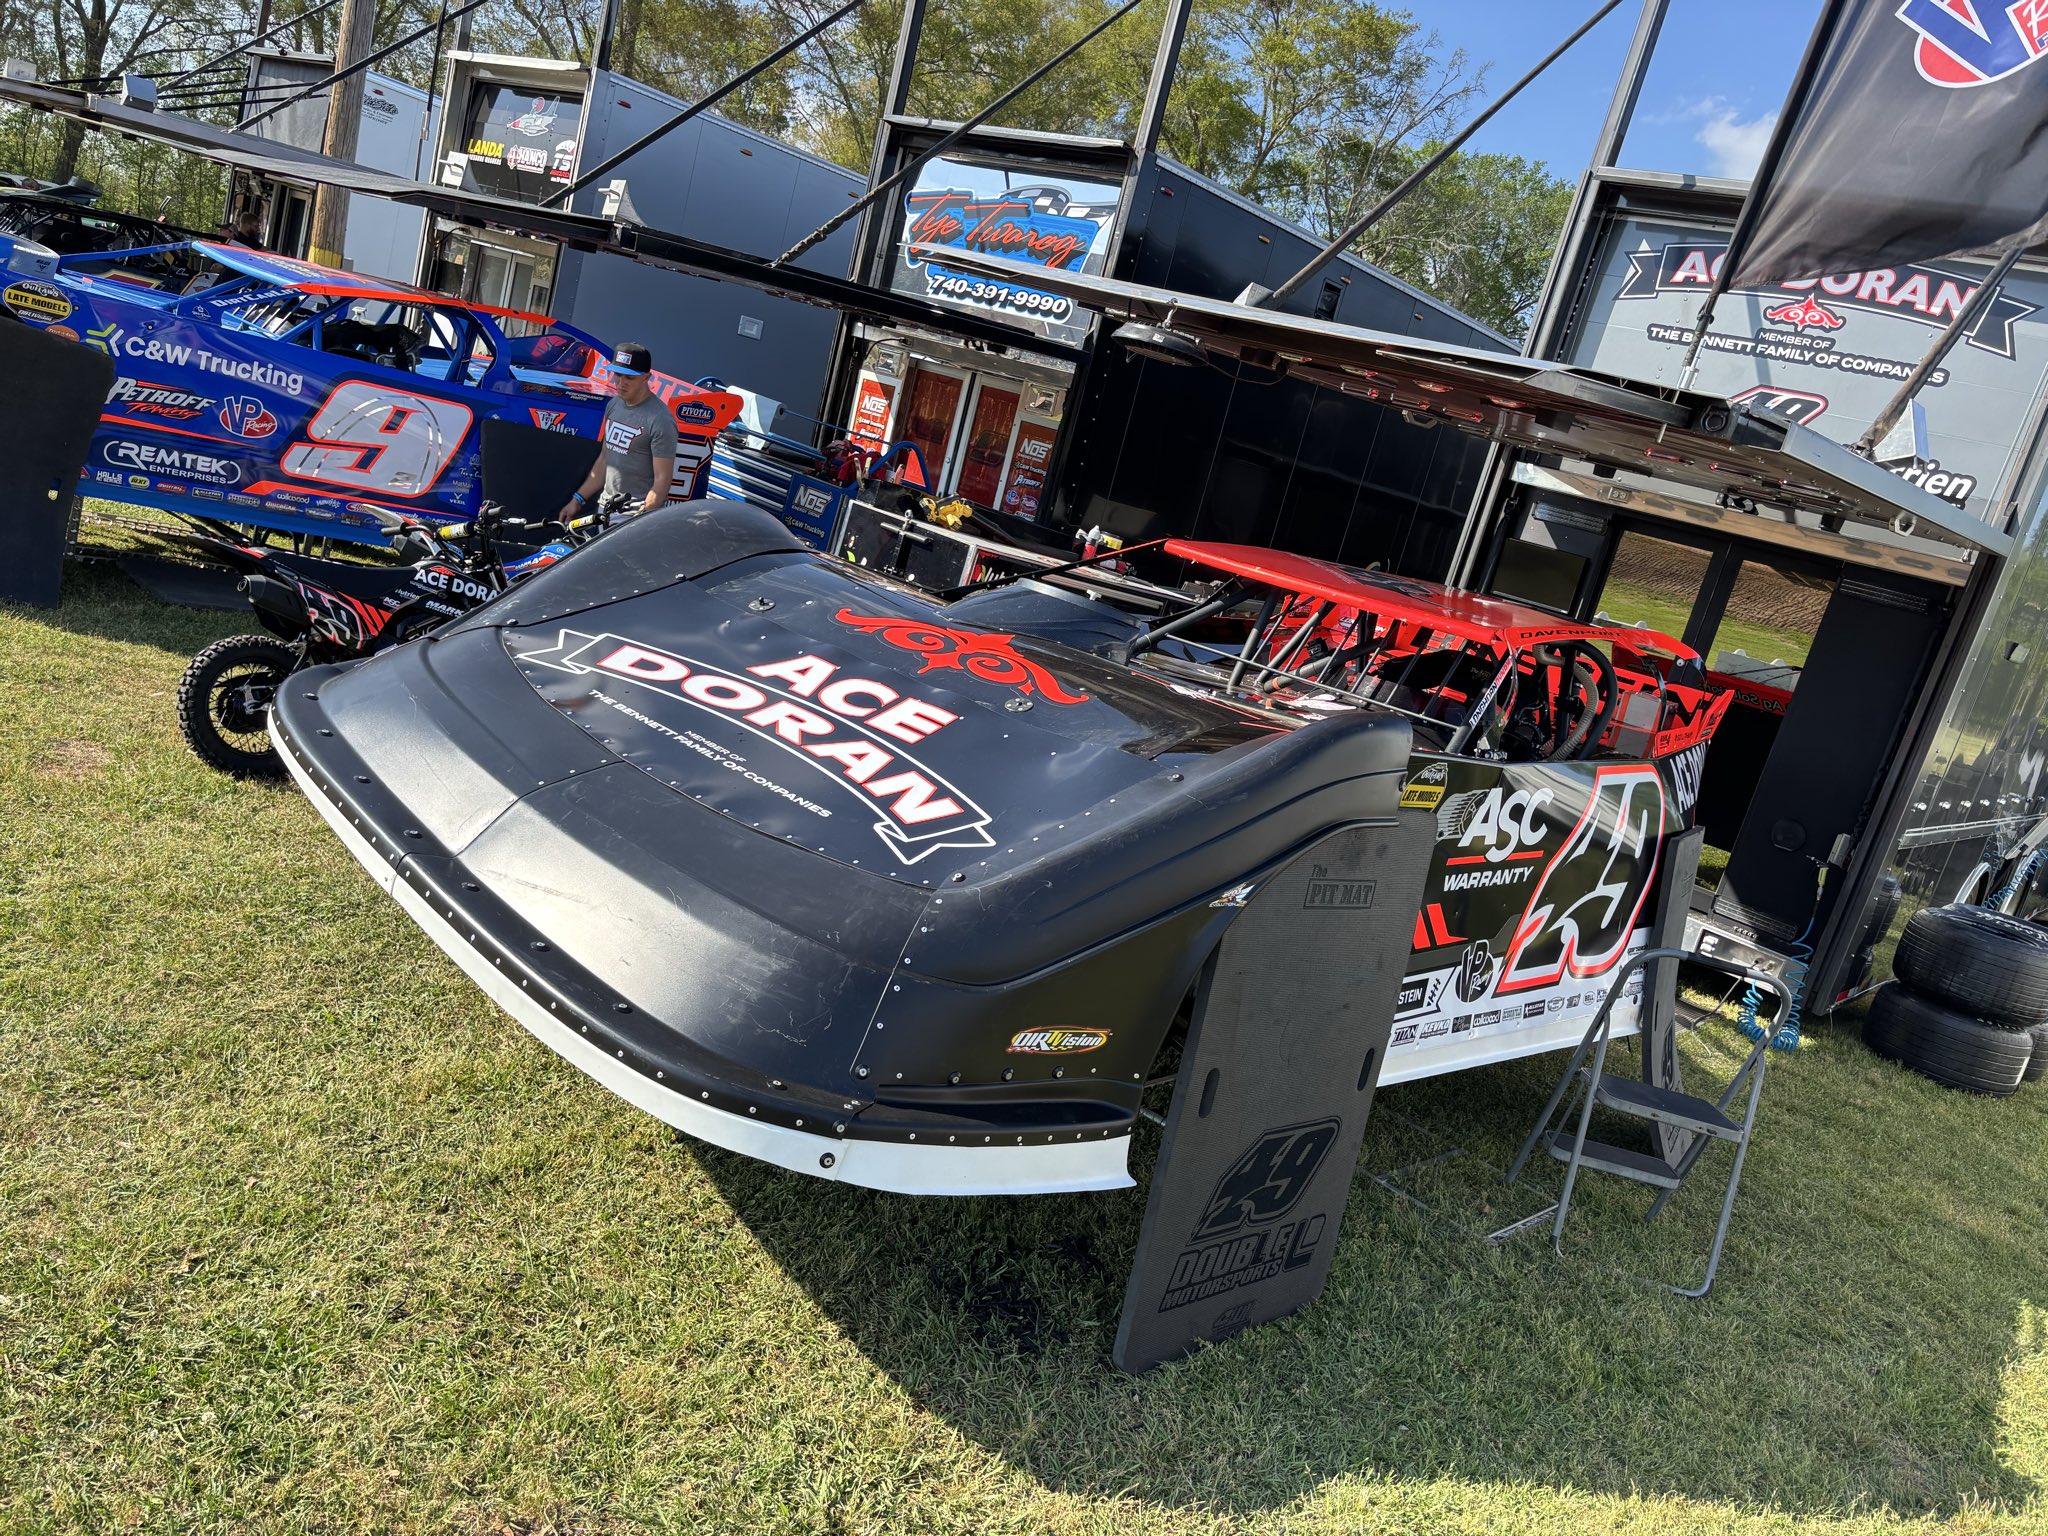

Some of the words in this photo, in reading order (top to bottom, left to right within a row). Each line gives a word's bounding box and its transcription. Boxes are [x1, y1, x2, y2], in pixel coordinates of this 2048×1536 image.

[468, 139, 504, 158] LANDA
[8, 291, 30, 305] LATE
[31, 297, 68, 313] MODELS
[932, 274, 1067, 314] 740-391-9990
[1650, 327, 1680, 342] THE
[1682, 331, 1754, 353] BNNETT
[1757, 344, 1815, 361] FAMILY
[1815, 352, 1841, 365] OF
[1759, 331, 1811, 346] MEMBER
[1812, 340, 1831, 349] OF
[126, 337, 192, 366] C&W
[197, 350, 303, 395] Trucking
[104, 376, 217, 410] PETROFF
[862, 394, 889, 413] NOS
[681, 407, 711, 418] PIVOTAL
[280, 379, 473, 498] 9
[1020, 438, 1053, 459] NOS
[118, 442, 231, 475] REMTEK
[149, 465, 227, 484] ENTERPRISES
[794, 484, 833, 514] NOS
[804, 523, 825, 538] Trucking
[414, 569, 448, 589] ACE
[452, 578, 499, 602] DORA
[1521, 629, 1623, 640] DAVENPORT
[748, 653, 959, 745] ACE
[596, 645, 965, 824] DORAN
[684, 730, 730, 754] MEMBER
[729, 753, 747, 763] OF
[588, 689, 618, 705] THE
[613, 703, 679, 736] BENNETT
[673, 735, 726, 761] FAMILY
[723, 760, 747, 773] OF
[743, 771, 833, 818] COMPANIES
[1402, 789, 1417, 802] LATE
[1416, 790, 1441, 803] MODELS
[1457, 788, 1555, 863] ASC
[1311, 863, 1328, 878] The
[1443, 866, 1535, 892] WARRANTY
[1309, 883, 1340, 905] PIT
[1340, 884, 1373, 905] MAT
[1397, 987, 1423, 1005] STEIN
[1393, 1025, 1418, 1041] TITAN
[1422, 1020, 1450, 1033] KEVKO
[1167, 1222, 1296, 1291] DOUBLE
[1158, 1258, 1283, 1313] MOTORSPORTS
